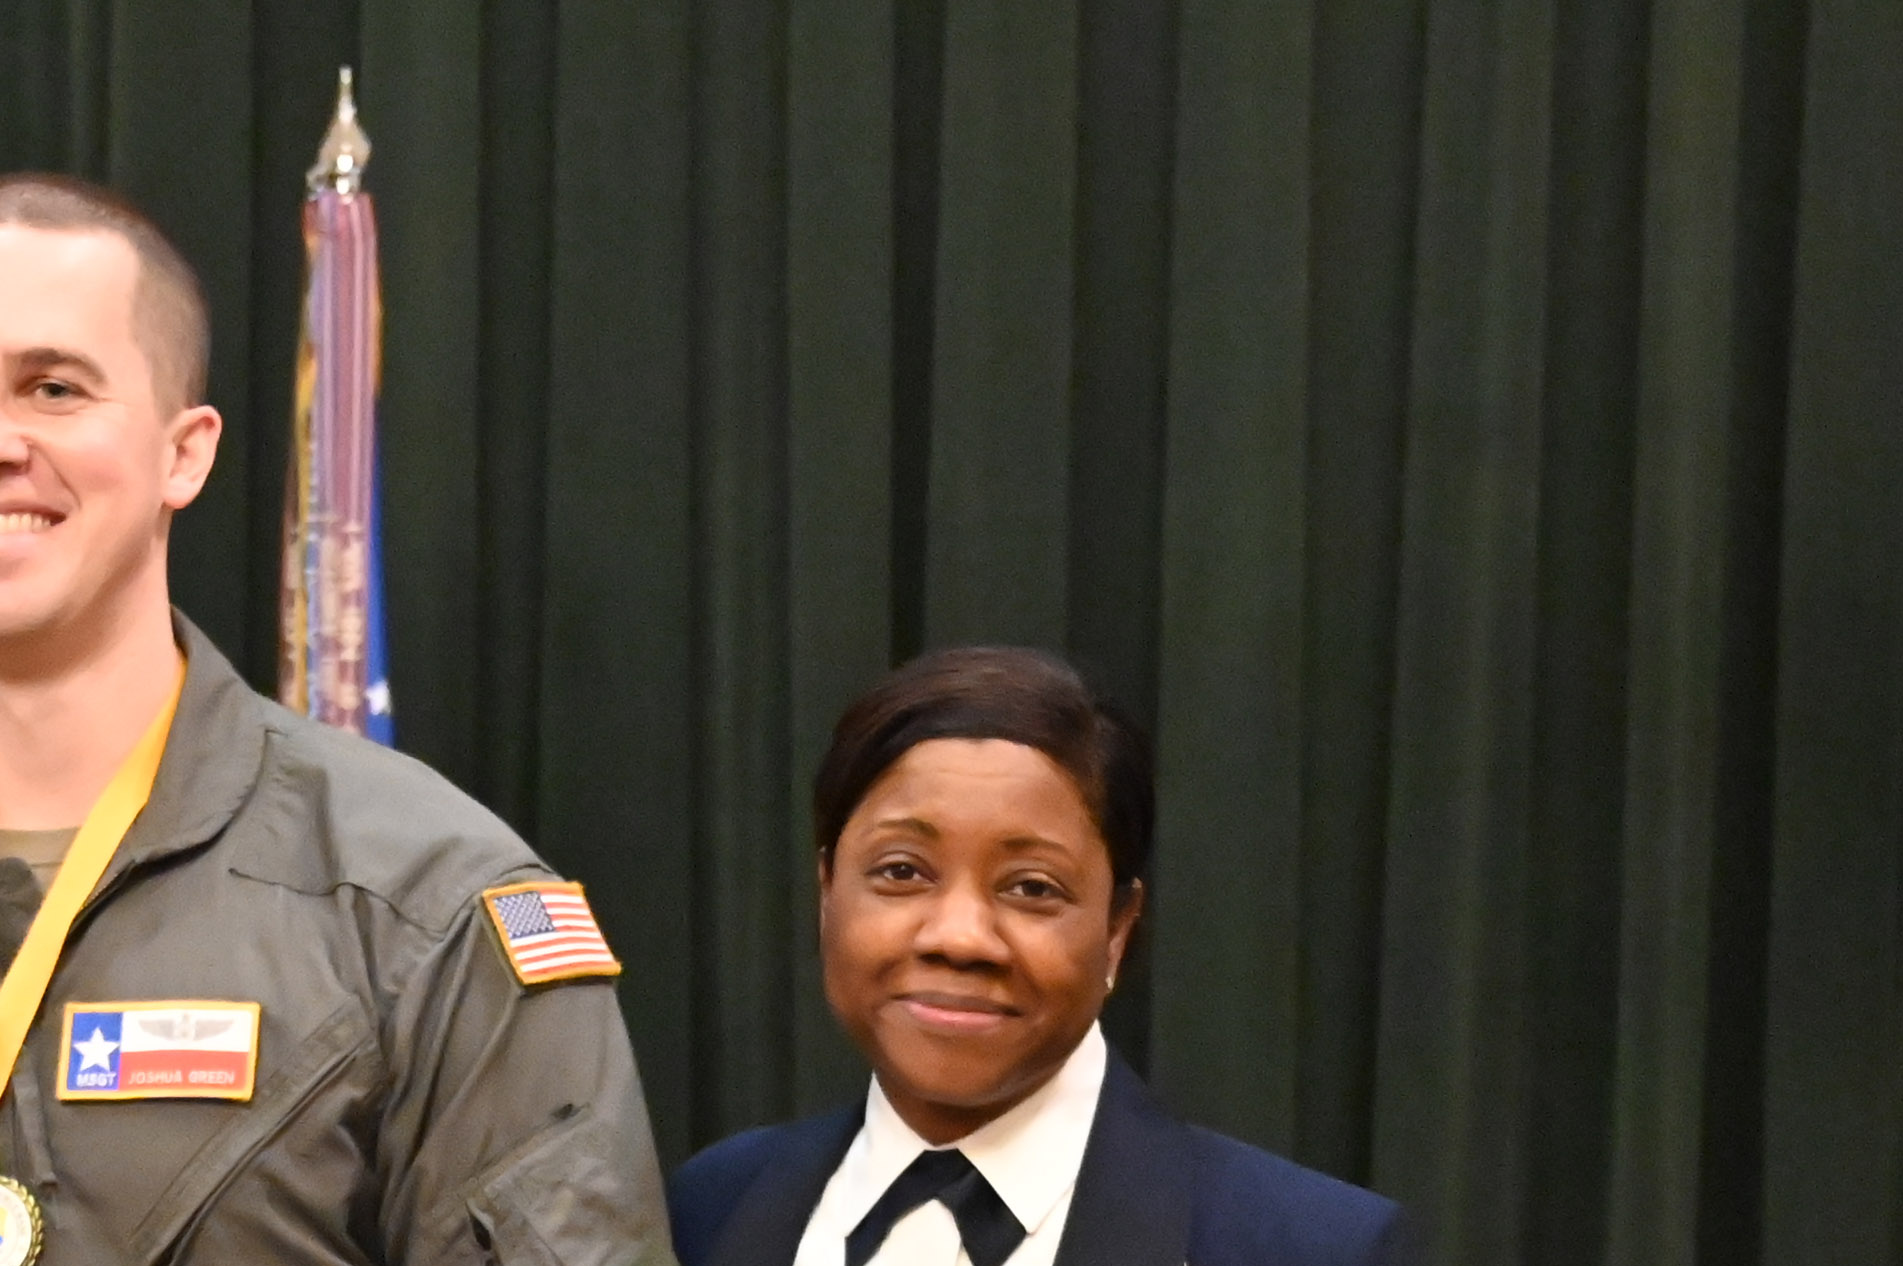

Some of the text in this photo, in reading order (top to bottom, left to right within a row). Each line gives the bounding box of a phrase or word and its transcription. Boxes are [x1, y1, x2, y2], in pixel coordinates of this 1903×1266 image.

[76, 1072, 117, 1088] MSGT
[128, 1070, 235, 1085] JOSHUA GREEN
